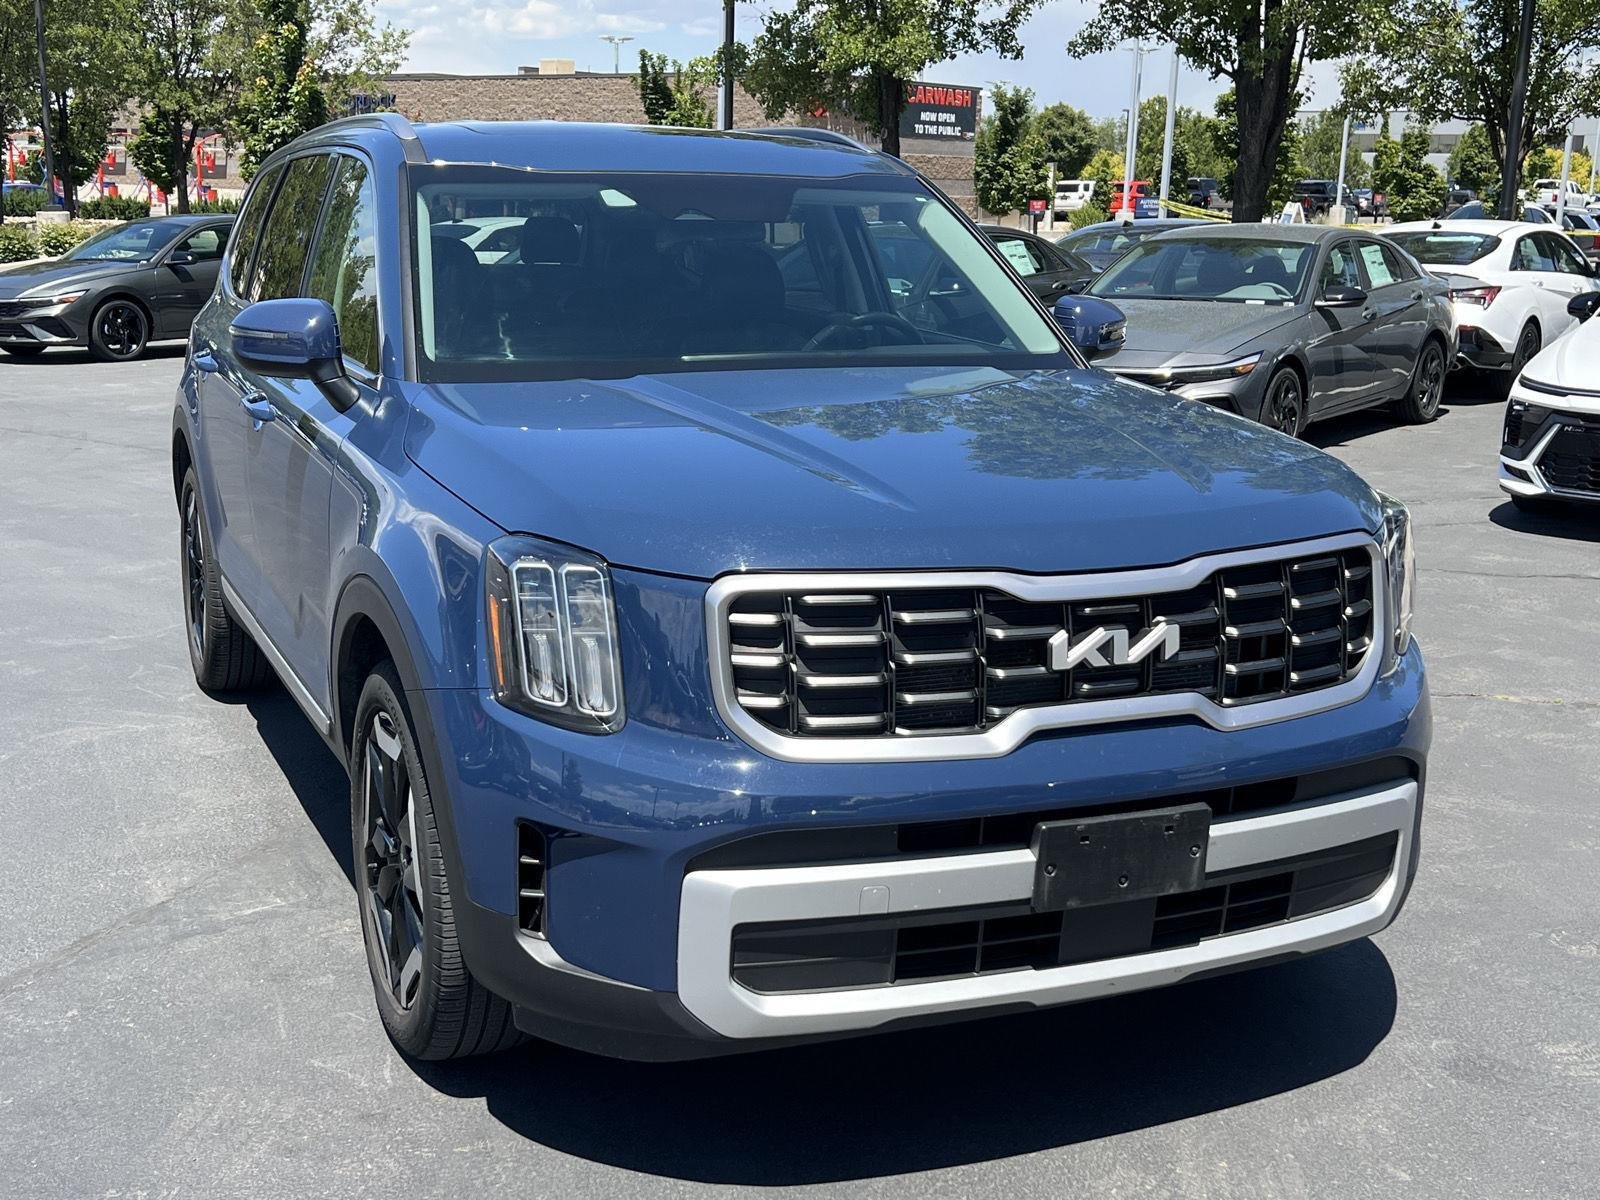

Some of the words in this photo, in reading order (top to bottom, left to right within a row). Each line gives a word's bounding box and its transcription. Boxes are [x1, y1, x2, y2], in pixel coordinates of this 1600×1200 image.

[920, 111, 937, 122] NOW
[938, 112, 956, 123] OPEN
[914, 124, 924, 134] TO
[924, 124, 937, 135] THE
[937, 125, 962, 136] PUBLIC
[1048, 620, 1180, 671] KIA
